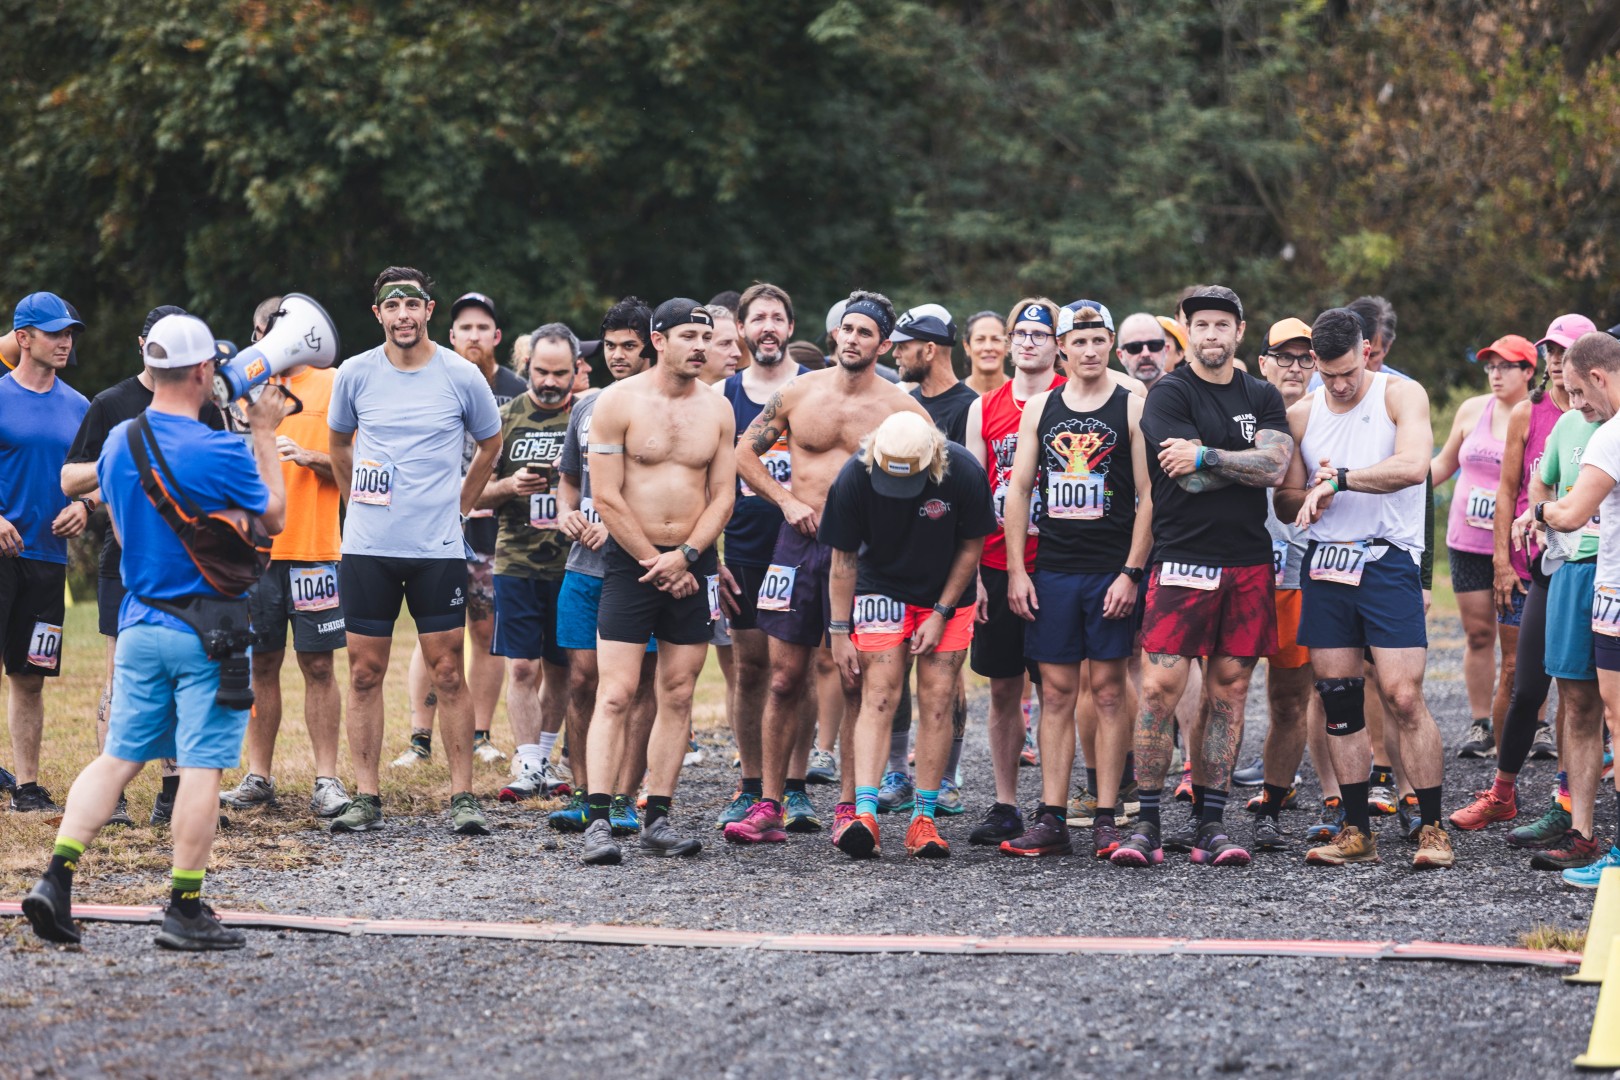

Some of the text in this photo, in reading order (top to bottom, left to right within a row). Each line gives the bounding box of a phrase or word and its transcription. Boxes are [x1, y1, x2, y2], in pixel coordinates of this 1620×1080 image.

[355, 467, 390, 494] 1009
[1053, 482, 1098, 509] 1001
[1317, 545, 1363, 574] 1007
[294, 574, 336, 601] 1046
[858, 597, 902, 624] 1000
[317, 618, 346, 633] LEHIGH
